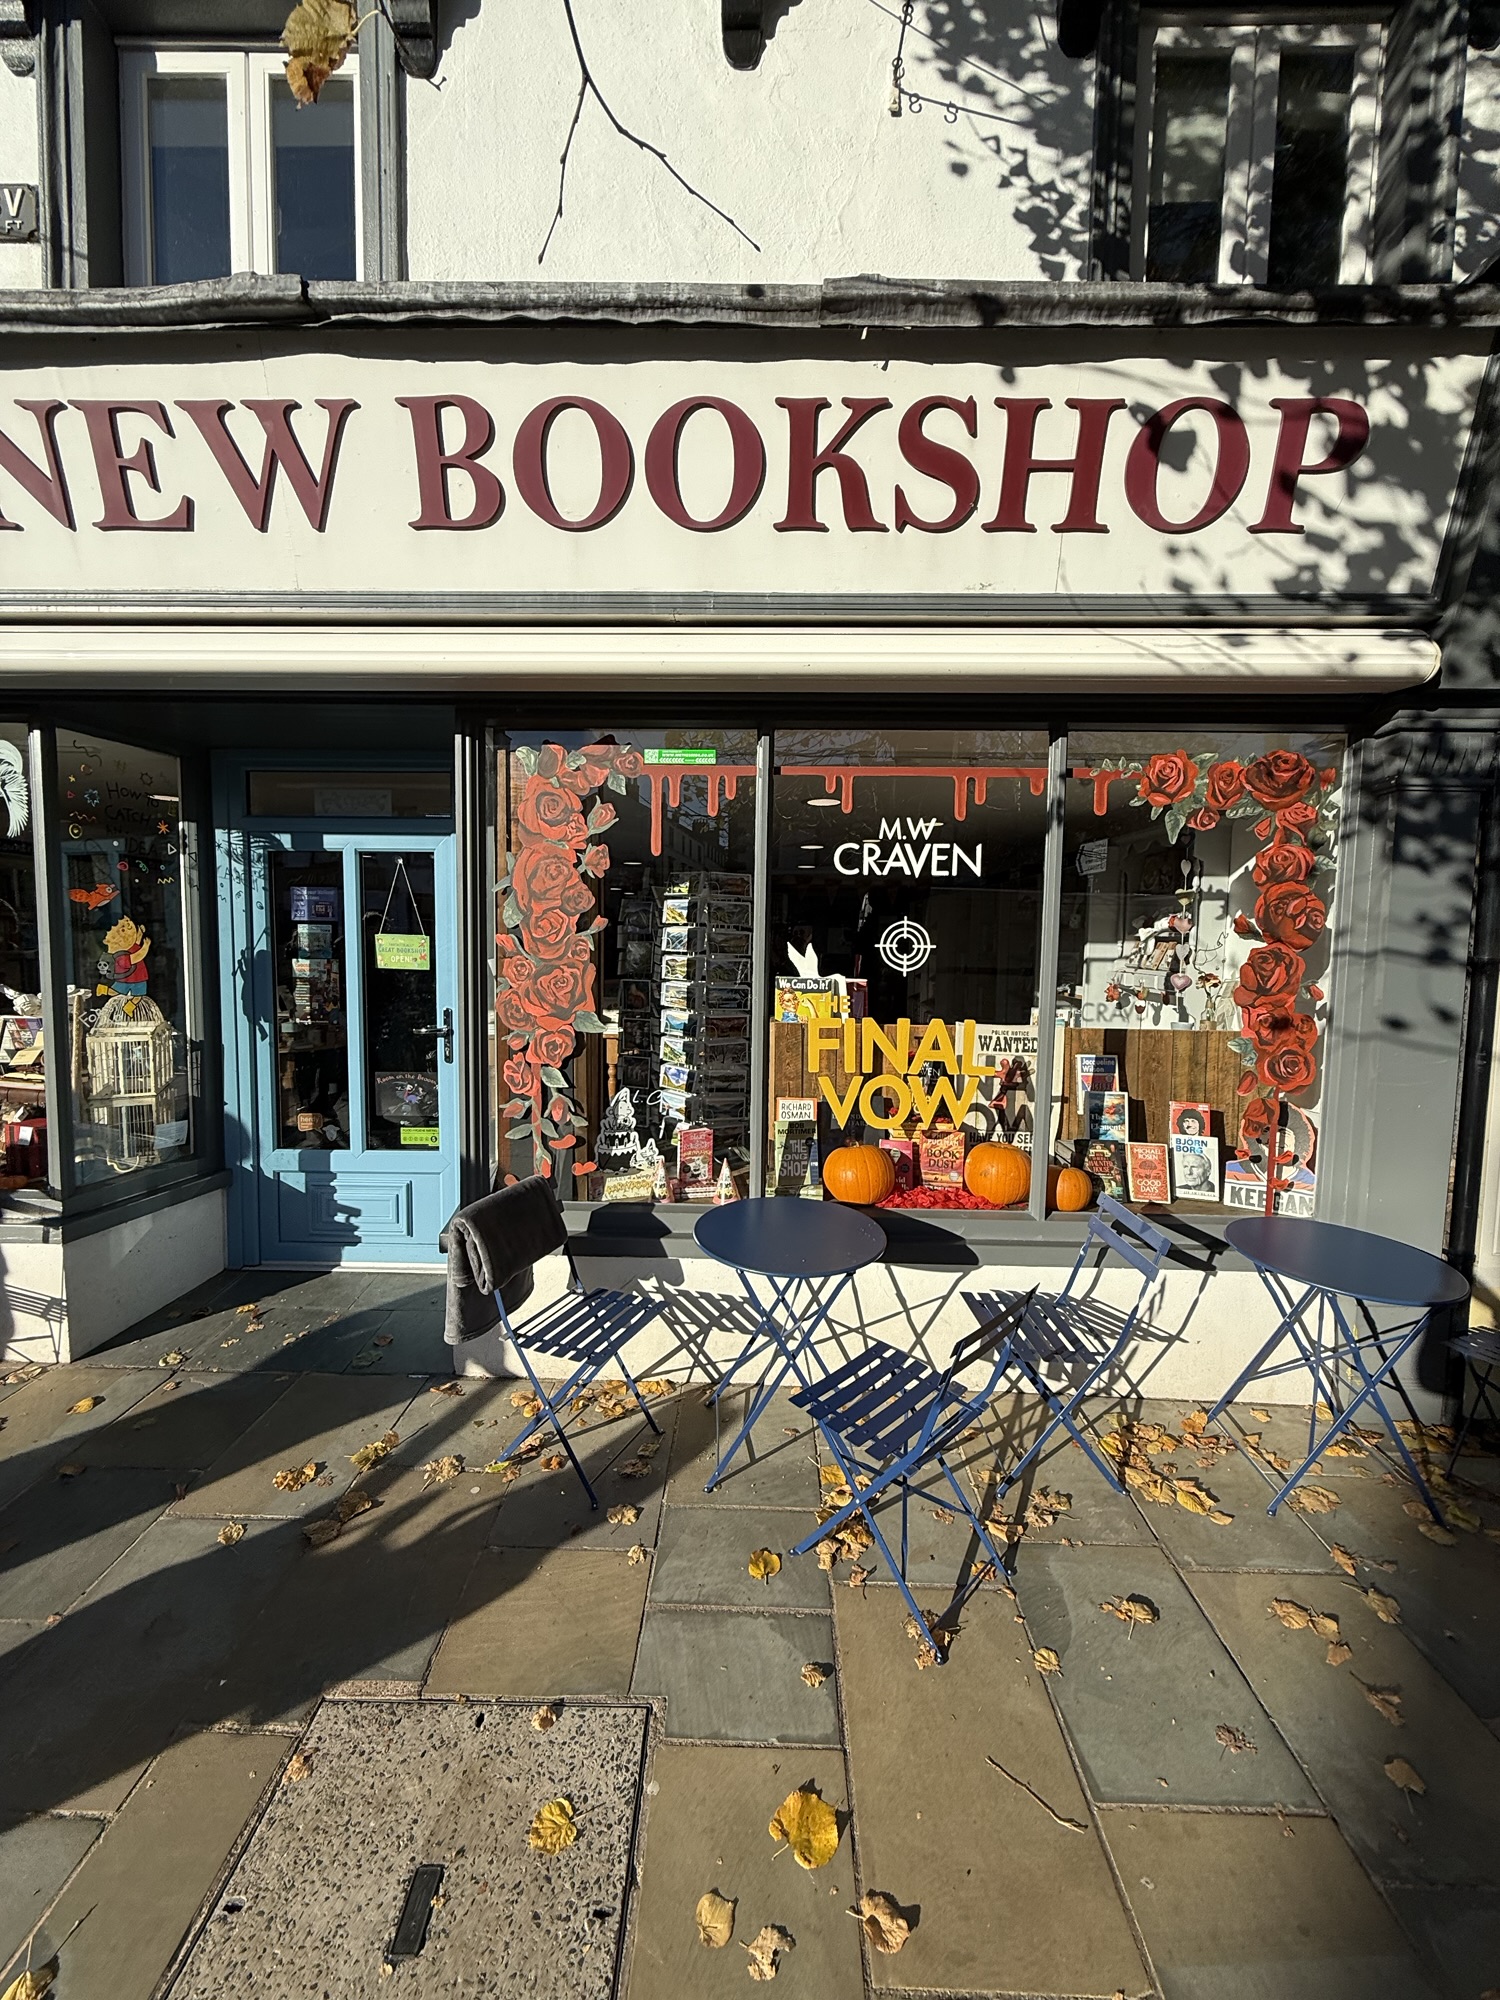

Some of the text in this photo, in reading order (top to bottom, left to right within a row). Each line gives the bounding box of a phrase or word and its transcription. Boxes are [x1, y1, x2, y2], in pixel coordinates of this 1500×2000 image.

[0, 395, 1371, 534] NEW BOOKSHOP
[833, 842, 983, 879] CRAVEN
[779, 979, 830, 990] We Can Do It!
[807, 1016, 996, 1077] FINAL
[978, 1034, 1038, 1053] WANTED
[781, 1102, 812, 1111] RICHARD
[817, 1073, 980, 1131] VOW
[781, 1110, 811, 1119] OSMAN
[969, 1132, 993, 1143] HAVE
[996, 1133, 1015, 1145] YOU
[1175, 1136, 1208, 1148] BJÖRN
[794, 1139, 807, 1153] THE
[1133, 1147, 1162, 1155] MICHAEL
[1175, 1145, 1204, 1154] BORG
[926, 1148, 960, 1160] BOOK
[1138, 1153, 1159, 1161] ROSEN
[780, 1160, 808, 1177] SHOE
[928, 1158, 956, 1169] DUST
[1136, 1179, 1162, 1188] GOOD
[1140, 1185, 1159, 1194] DAYS
[1229, 1185, 1314, 1214] KEEGAN
